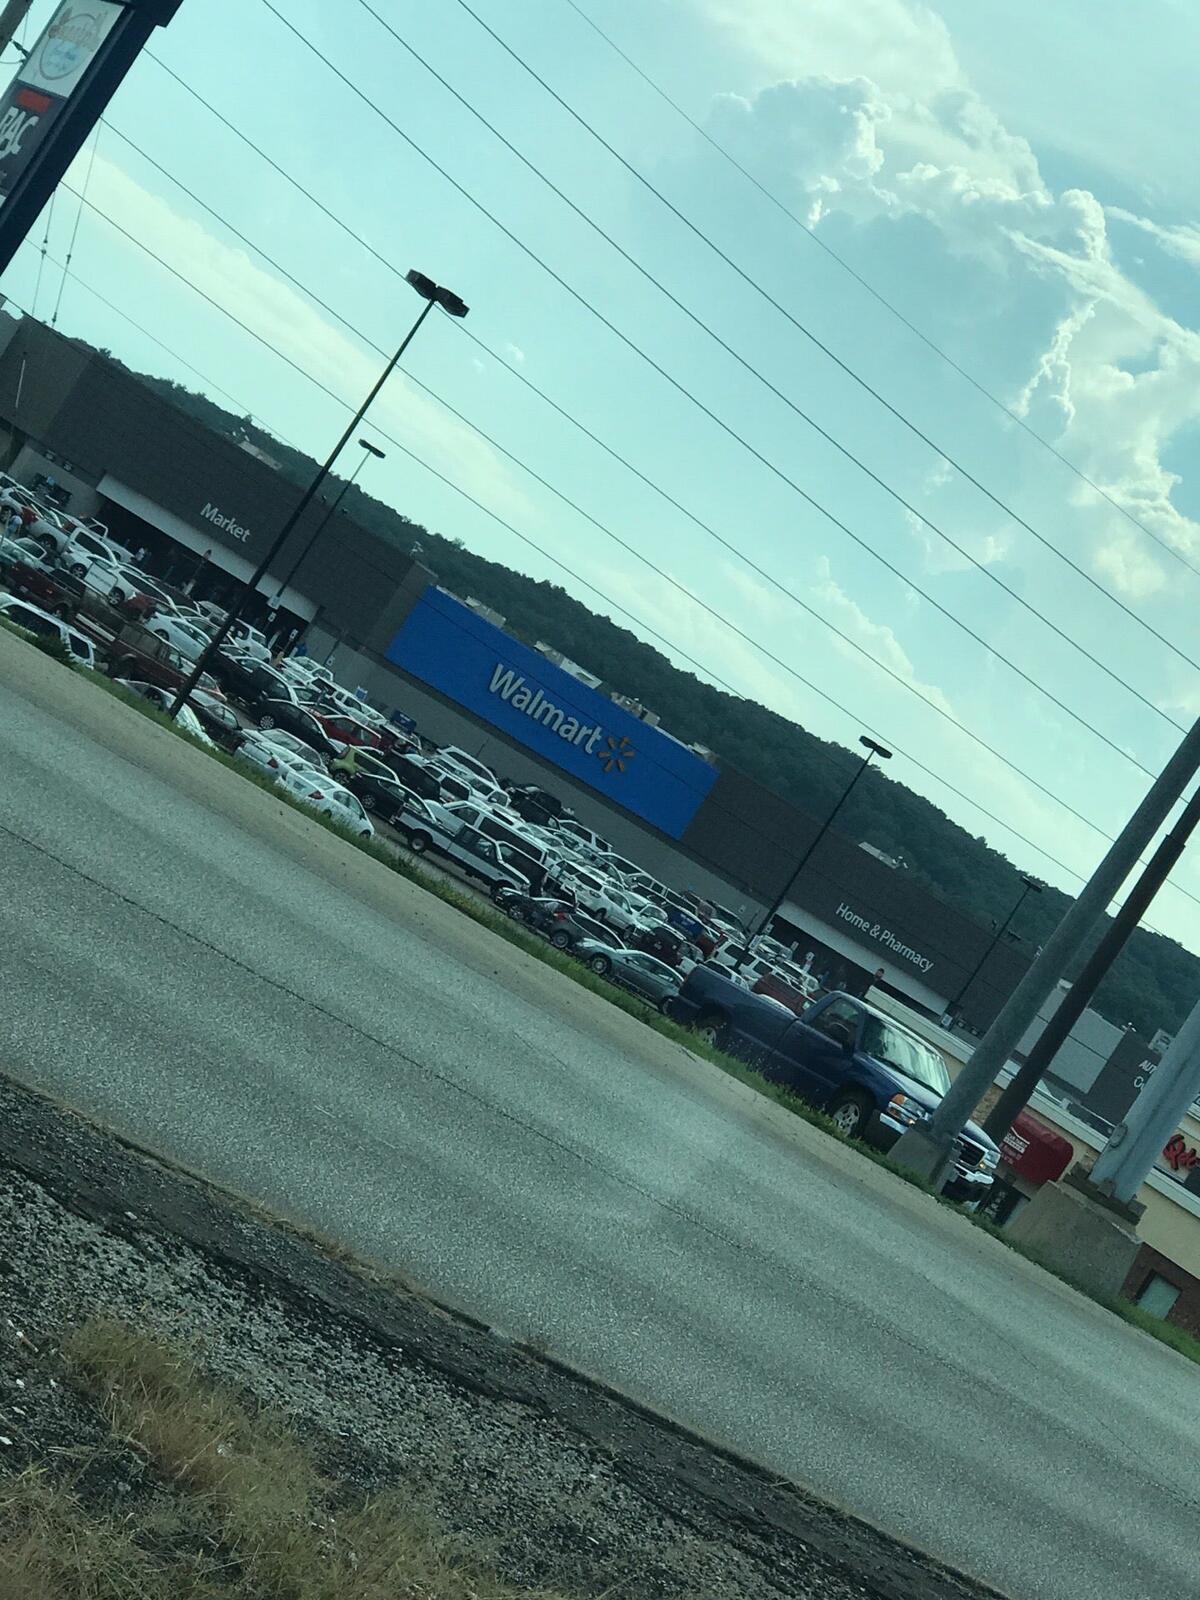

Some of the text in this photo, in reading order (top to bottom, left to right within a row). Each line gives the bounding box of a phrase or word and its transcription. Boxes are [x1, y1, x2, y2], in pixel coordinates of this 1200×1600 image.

[200, 502, 251, 543] Market
[489, 663, 602, 754] Walmart
[836, 902, 934, 973] Home & Pharmacy
[1138, 1060, 1158, 1074] AUT
